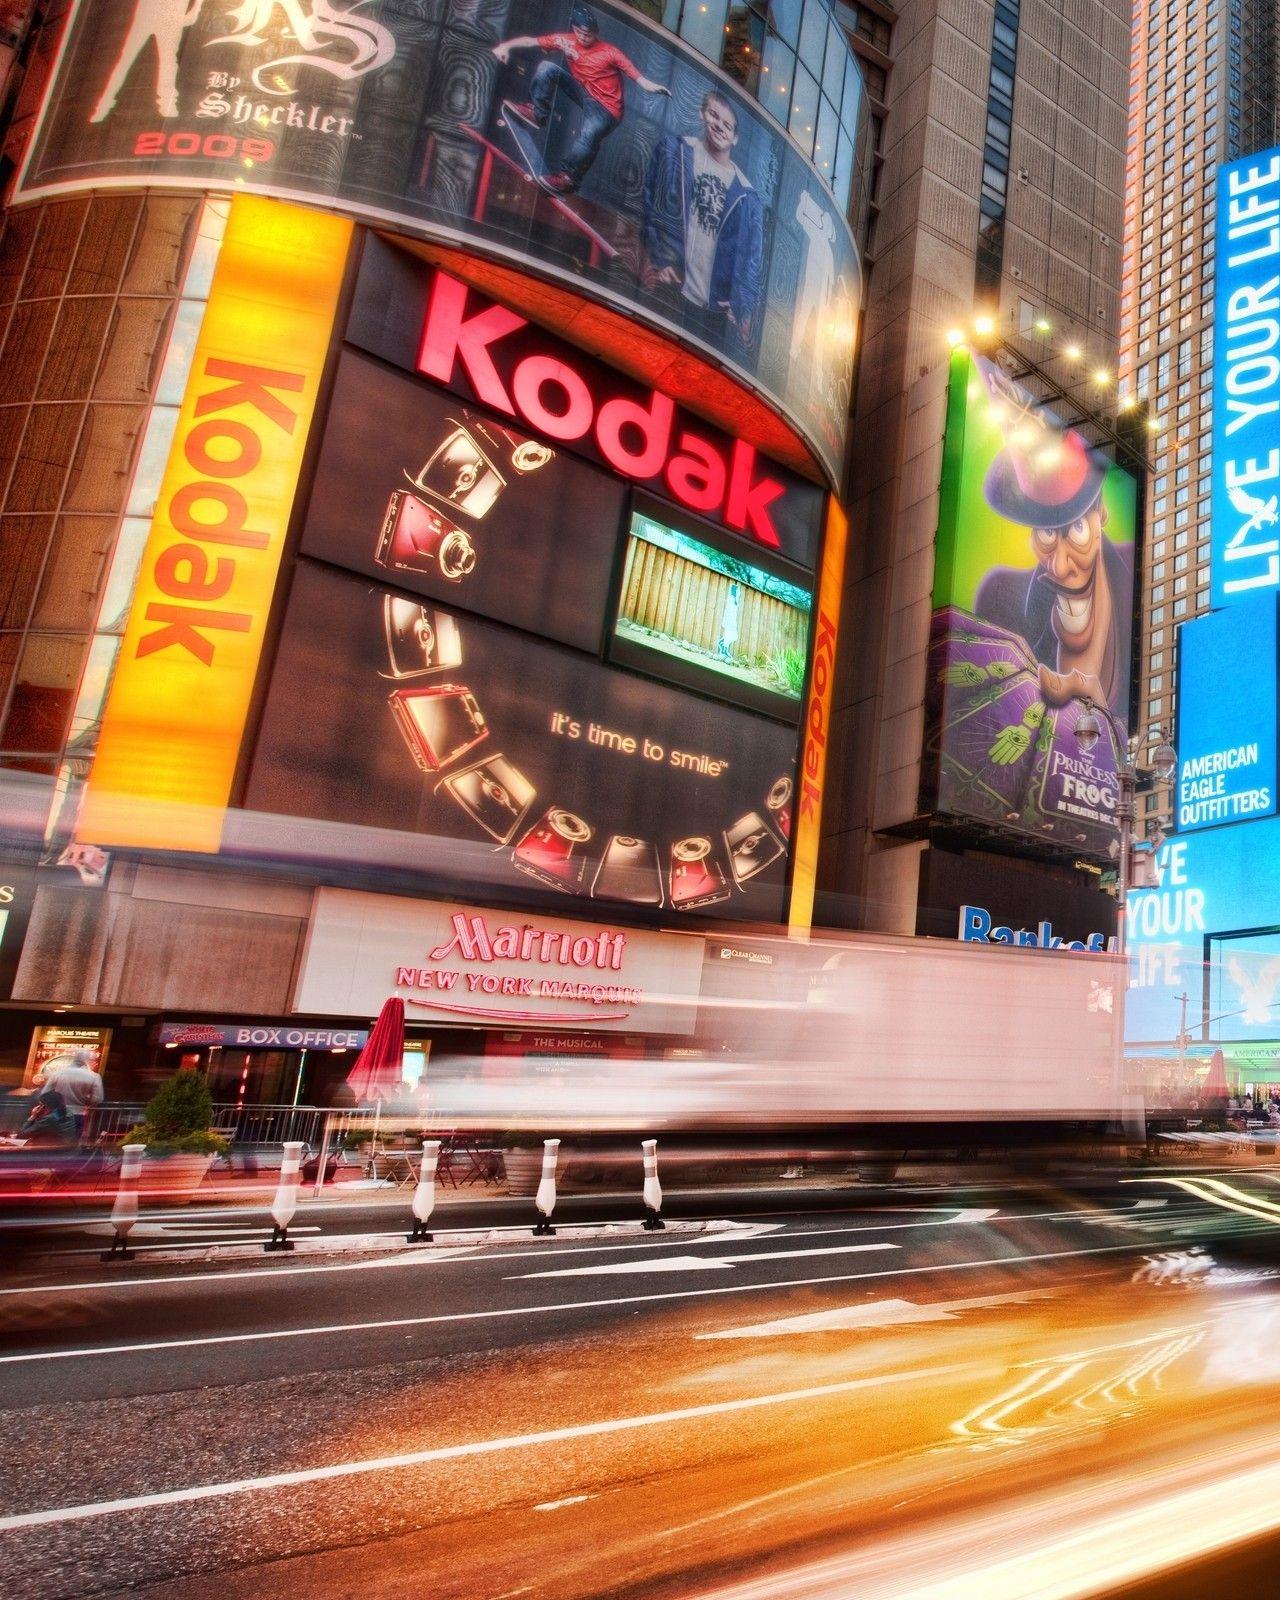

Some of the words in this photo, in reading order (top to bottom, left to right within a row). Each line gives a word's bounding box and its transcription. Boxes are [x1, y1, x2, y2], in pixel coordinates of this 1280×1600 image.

[206, 71, 240, 92] By
[133, 131, 275, 163] 2009
[1228, 154, 1280, 269] LIFE
[1225, 274, 1280, 437] YOUR
[416, 269, 786, 549] Kodak
[135, 356, 306, 668] Kodak
[551, 711, 580, 740] it's
[587, 723, 637, 754] time
[642, 738, 665, 762] to
[801, 611, 837, 824] Kodak
[1051, 750, 1120, 790] PRINCESS
[1182, 742, 1258, 778] AMERICAN
[1060, 772, 1118, 809] FROG
[1180, 787, 1271, 826] OUTFITTERS
[1181, 773, 1226, 801] EAGLE
[1153, 841, 1188, 888] VE
[1126, 888, 1206, 939] YOUR
[430, 912, 627, 970] Marriott
[397, 967, 459, 990] NEW
[466, 972, 533, 996] YORK
[541, 980, 643, 1005] MARQUIS
[236, 1029, 281, 1044] BOX
[286, 1031, 360, 1047] OFFICE
[534, 1038, 555, 1047] THE
[558, 1040, 604, 1049] MUSICAL
[1233, 1049, 1277, 1058] AMERICAN
